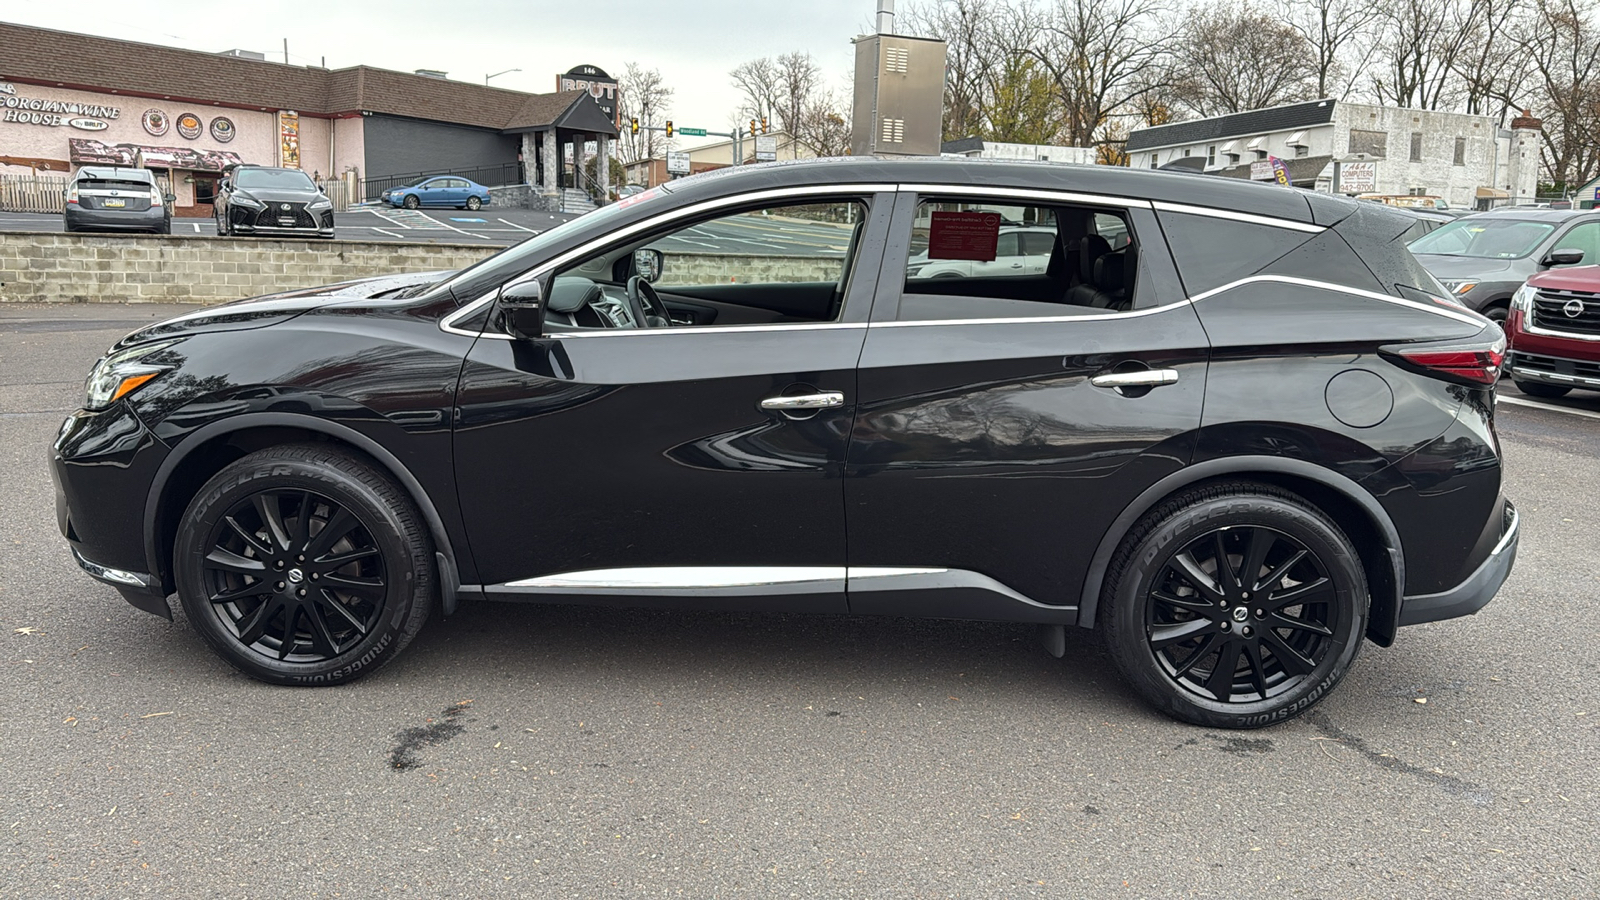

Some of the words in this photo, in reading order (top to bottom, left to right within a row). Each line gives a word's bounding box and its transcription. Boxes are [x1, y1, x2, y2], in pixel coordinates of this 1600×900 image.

[0, 95, 73, 114] EORGIAN
[76, 103, 121, 119] WINE
[4, 109, 62, 127] HOUSE
[84, 120, 104, 128] BRUT
[599, 105, 611, 113] AR
[1341, 170, 1374, 178] COMPUTERS
[1340, 184, 1374, 192] 942-9700
[193, 466, 293, 523] DUELER
[1144, 503, 1251, 566] DUELER
[292, 632, 393, 683] BRIDGESTONE
[1236, 667, 1340, 727] BRIDGESTONE
